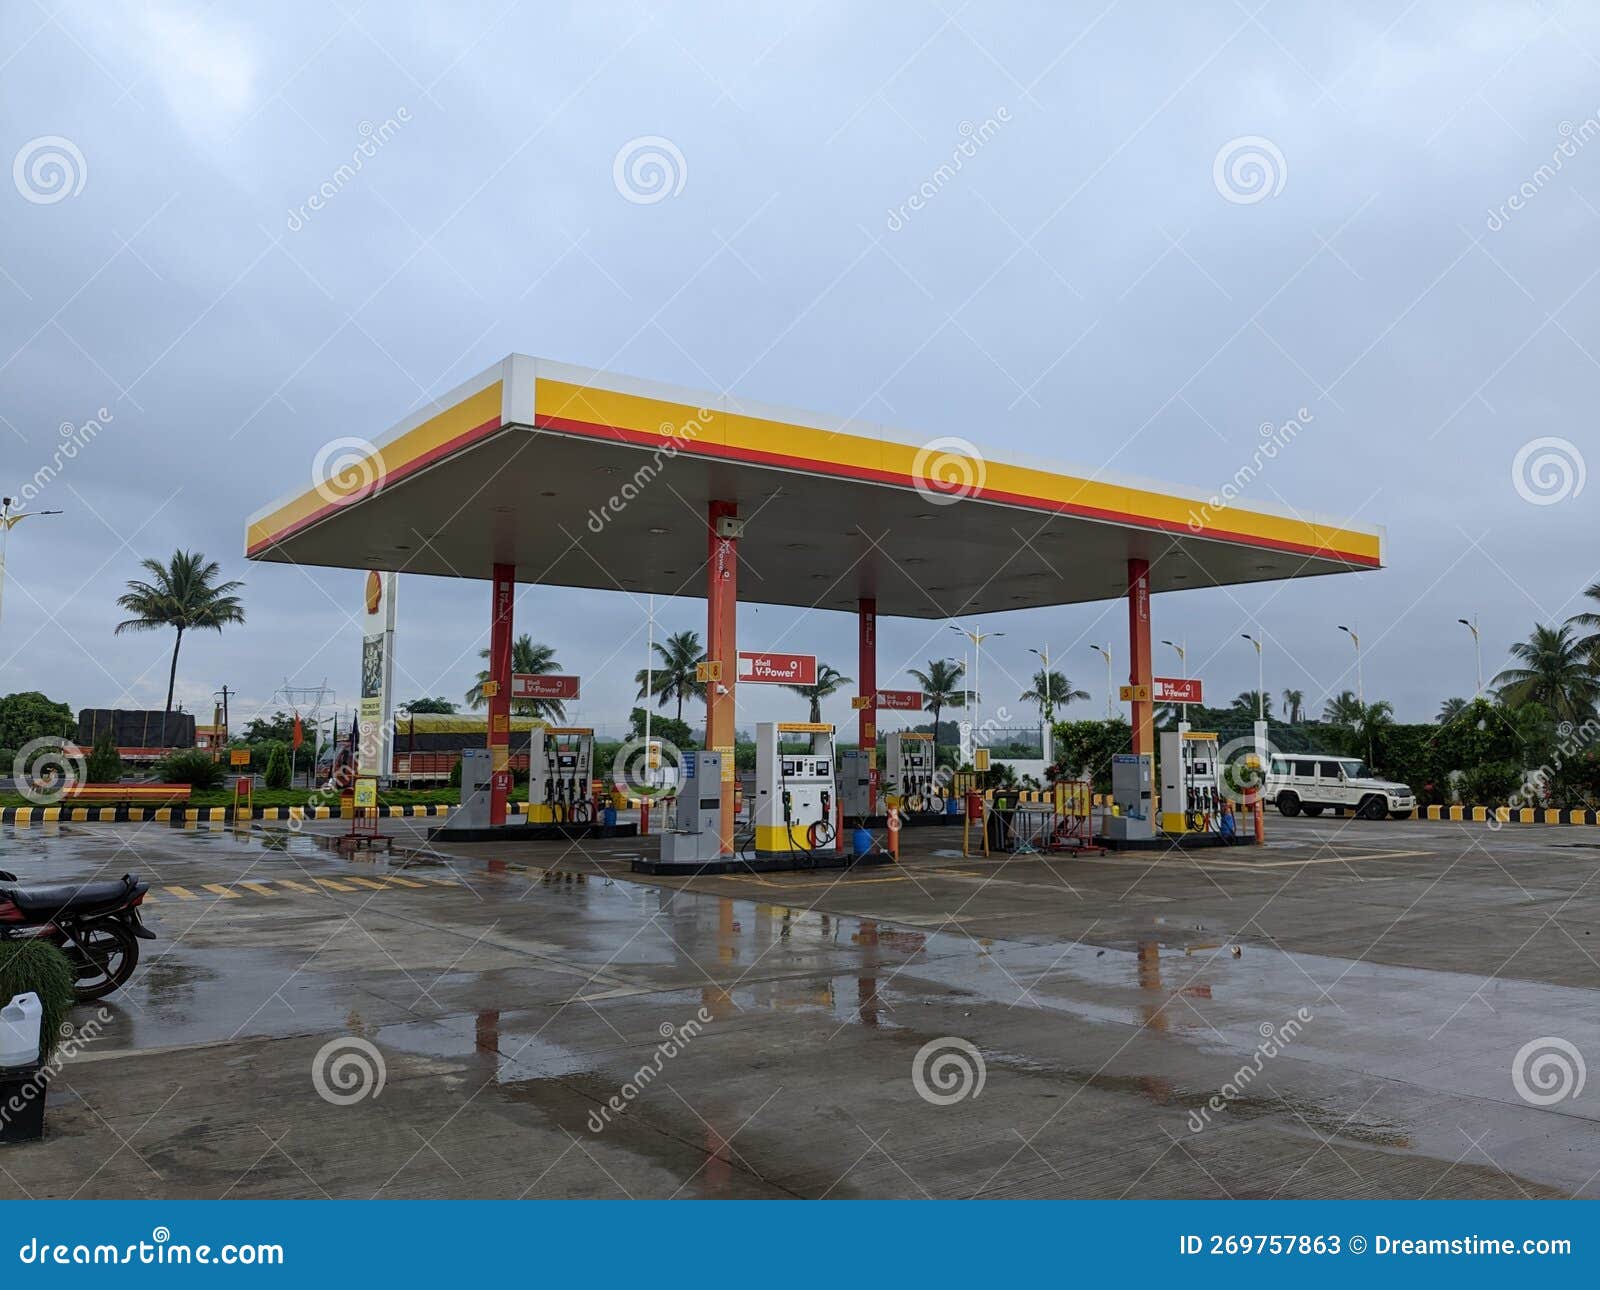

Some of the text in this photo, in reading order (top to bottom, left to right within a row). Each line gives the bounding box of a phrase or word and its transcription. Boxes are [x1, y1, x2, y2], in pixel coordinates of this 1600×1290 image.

[755, 659, 771, 667] Shell
[755, 667, 795, 678] V-Power
[527, 685, 561, 694] V-Power
[1164, 689, 1189, 698] V-Power
